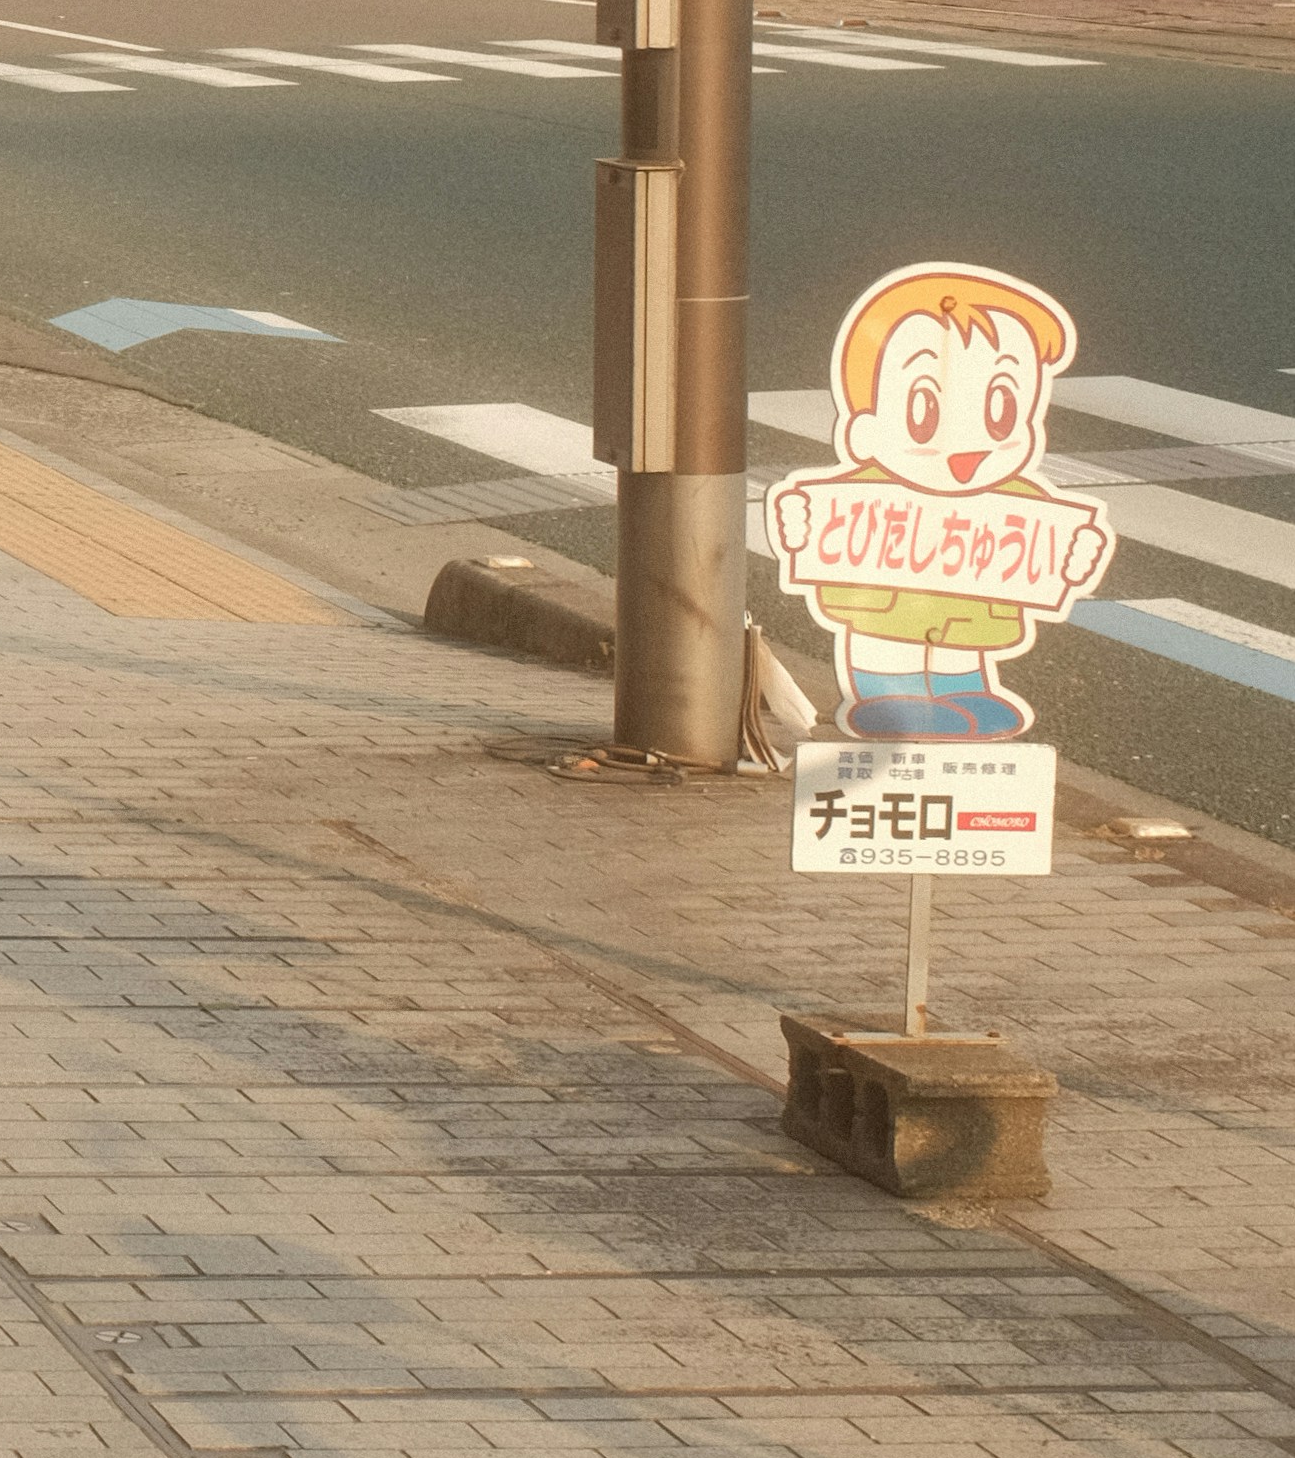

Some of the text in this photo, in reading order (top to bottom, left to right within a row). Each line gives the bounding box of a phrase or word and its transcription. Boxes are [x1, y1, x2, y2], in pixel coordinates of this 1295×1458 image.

[818, 498, 1055, 584] とびだしちゅうい
[839, 751, 873, 764] 高価
[891, 753, 926, 764] 新車
[838, 767, 873, 779] 買取
[889, 768, 925, 780] 中古車
[943, 762, 1017, 775] 販売修理
[810, 789, 953, 840] チョモロ
[860, 848, 1006, 866] 935-8895
